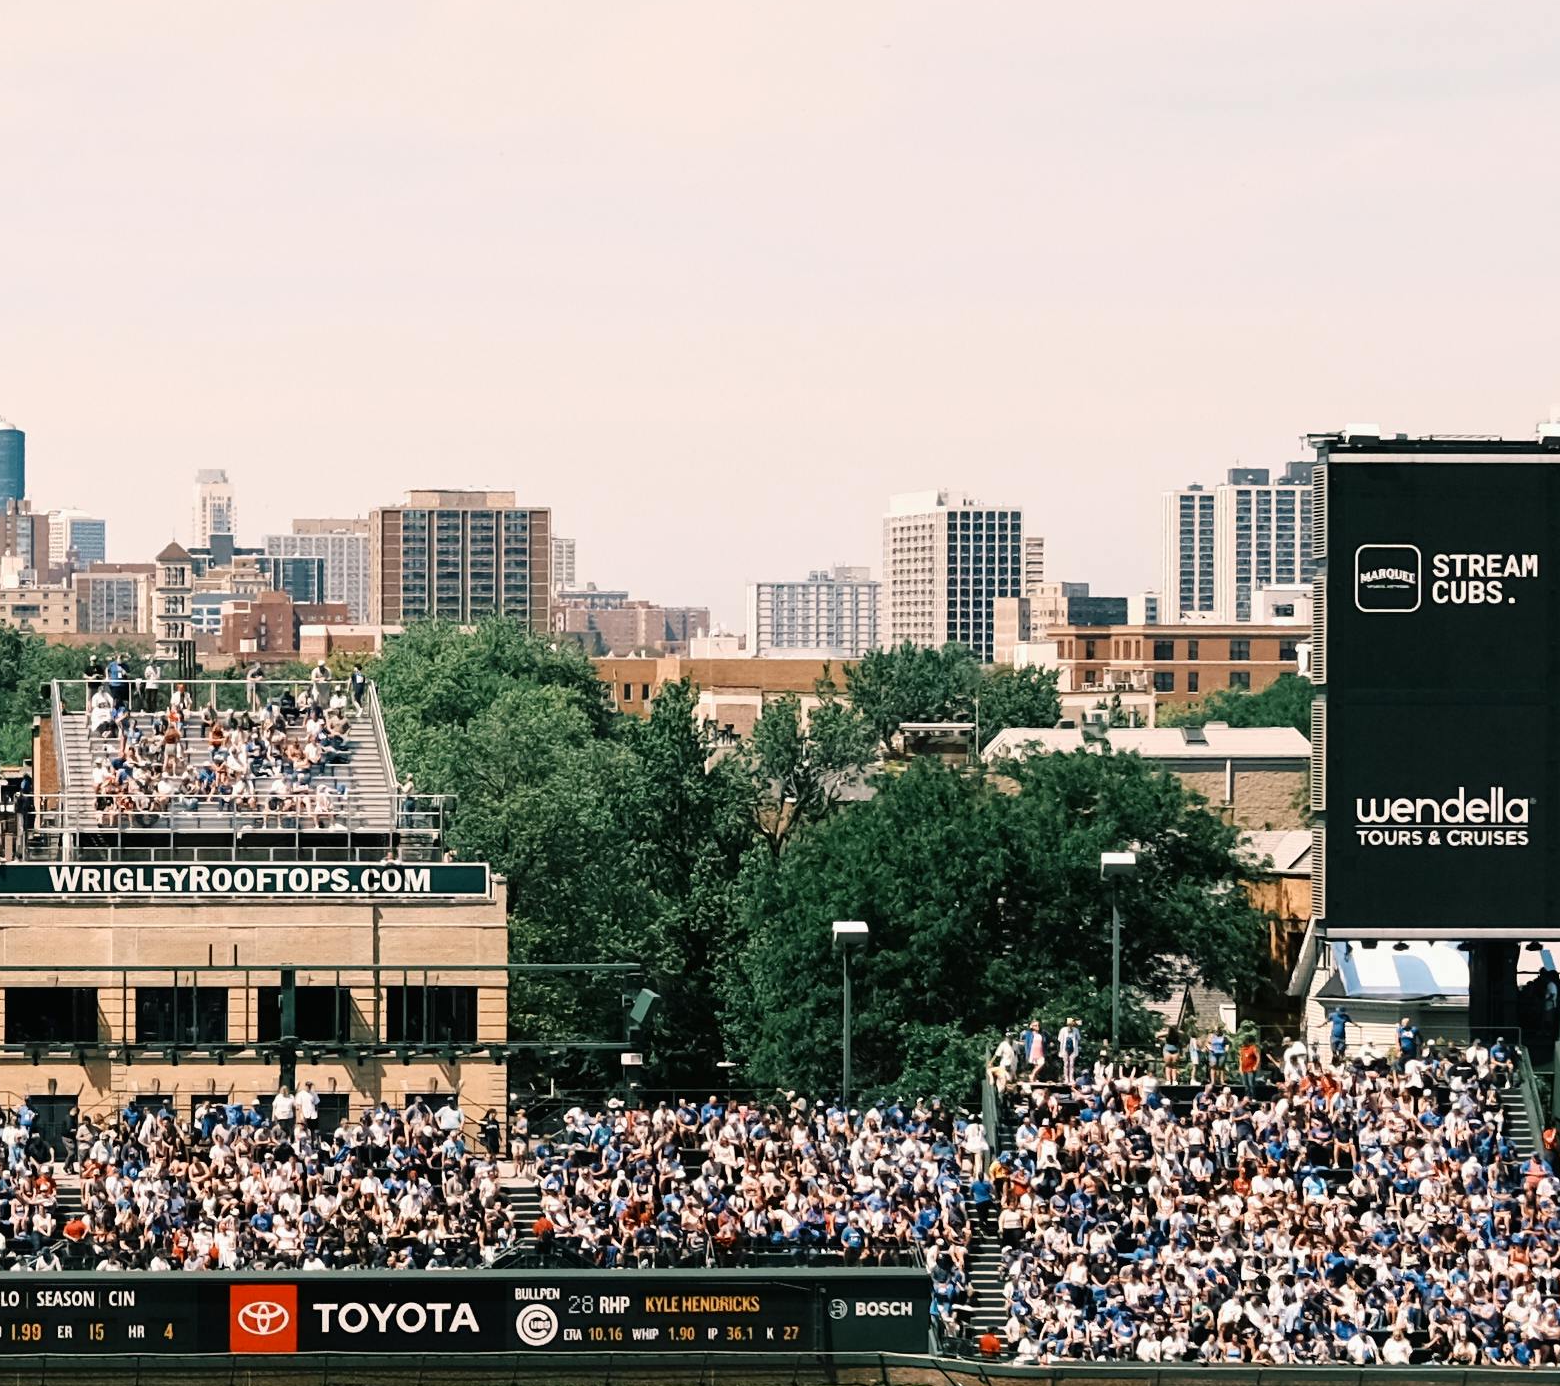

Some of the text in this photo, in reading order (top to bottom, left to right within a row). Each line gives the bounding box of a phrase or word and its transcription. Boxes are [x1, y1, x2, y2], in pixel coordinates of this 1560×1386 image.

[1432, 553, 1539, 578] STREAM
[1359, 567, 1417, 585] MARQUEE
[1432, 580, 1516, 604] CUBS.
[1356, 786, 1529, 824] wendella
[1356, 829, 1530, 846] TOURS & CRUISES
[36, 1290, 95, 1308] SEASON
[108, 1290, 135, 1307] CIN
[514, 1287, 560, 1300] BULLPEN
[568, 1295, 760, 1314] 28 RHP KYLE HENDRICKS
[855, 1301, 913, 1316] BOSCH
[312, 1302, 480, 1333] TOYOTA
[57, 1324, 73, 1340] ER
[89, 1324, 105, 1342] 15
[128, 1324, 145, 1340] HR
[164, 1324, 173, 1342] 4
[563, 1327, 799, 1341] ERA 10.16 WHIP 1.90 IP 36.1 K 27
